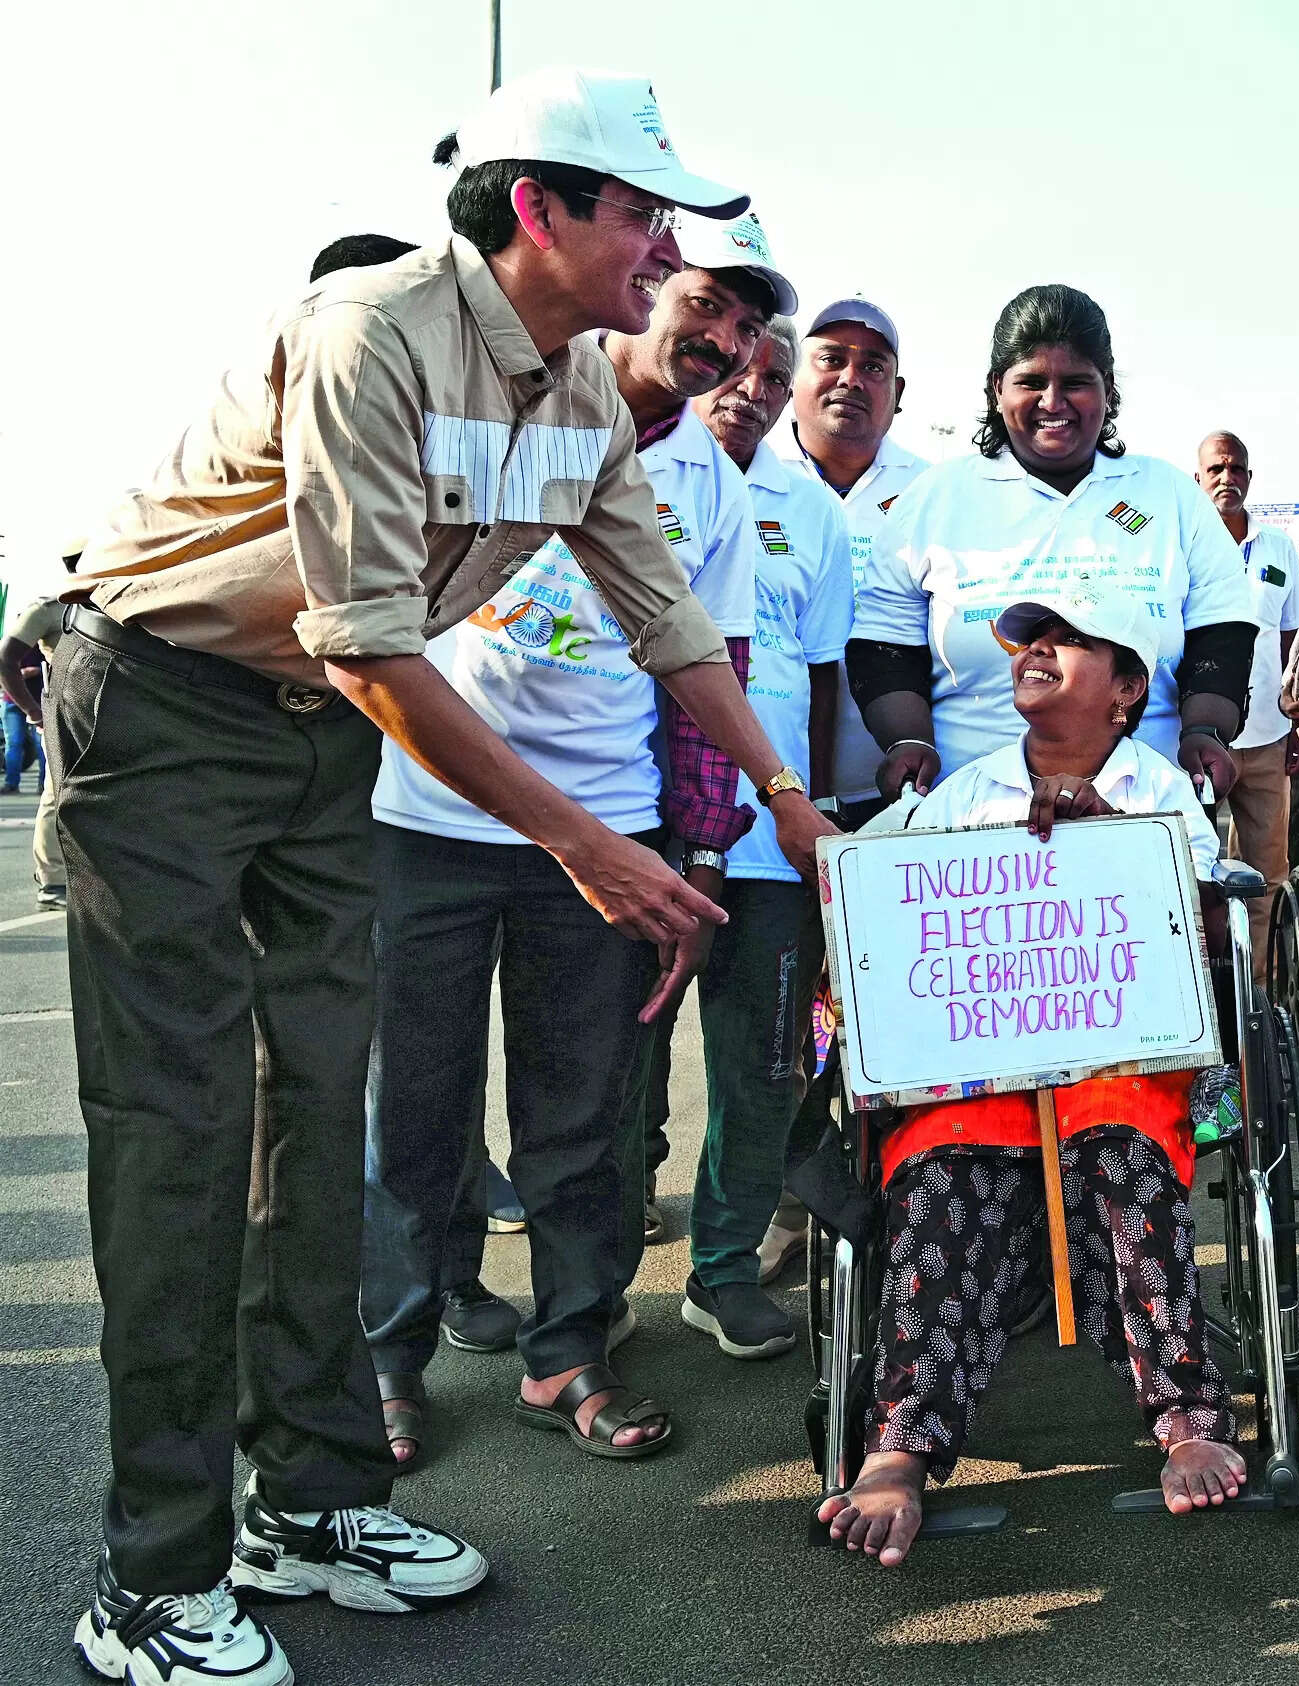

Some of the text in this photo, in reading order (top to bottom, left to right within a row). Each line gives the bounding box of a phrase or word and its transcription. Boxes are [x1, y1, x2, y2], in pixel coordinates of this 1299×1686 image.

[1134, 566, 1161, 578] 2024
[1145, 602, 1167, 619] TE
[895, 849, 1058, 905] INCLUSIVE
[920, 894, 1130, 954] ELECTION IS
[908, 942, 1101, 998] CELEBRATION
[1111, 940, 1146, 983] OF
[946, 986, 1124, 1042] DEMOCRACY
